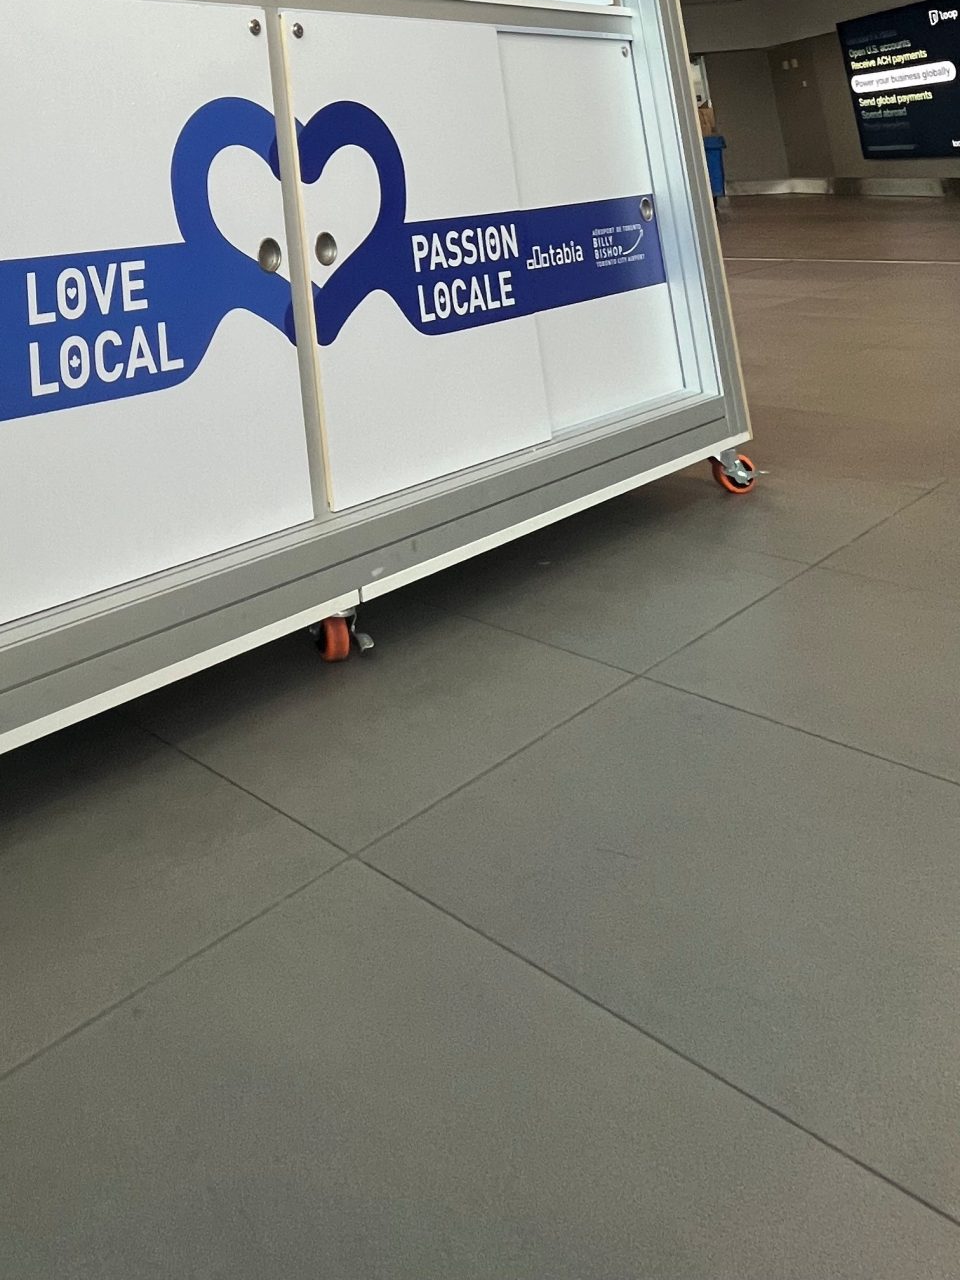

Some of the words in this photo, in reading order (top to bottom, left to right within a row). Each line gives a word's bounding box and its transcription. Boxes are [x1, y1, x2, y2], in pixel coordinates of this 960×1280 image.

[939, 9, 958, 20] loop
[848, 48, 866, 59] Open
[880, 39, 911, 52] accounts
[850, 59, 876, 70] Receive
[876, 55, 892, 66] ACH
[892, 49, 928, 66] payments
[855, 79, 874, 88] Power
[875, 76, 890, 87] your
[890, 72, 921, 83] business
[922, 66, 950, 81] globally
[859, 96, 876, 107] Send
[876, 94, 897, 107] global
[897, 90, 933, 105] payments
[411, 223, 519, 272] PASSION
[592, 235, 613, 248] BILLY
[549, 240, 584, 266] tabia
[594, 246, 623, 260] BISHOP
[26, 260, 149, 326] LOVE
[417, 270, 516, 323] LOCALE
[29, 321, 185, 397] LOCAL
